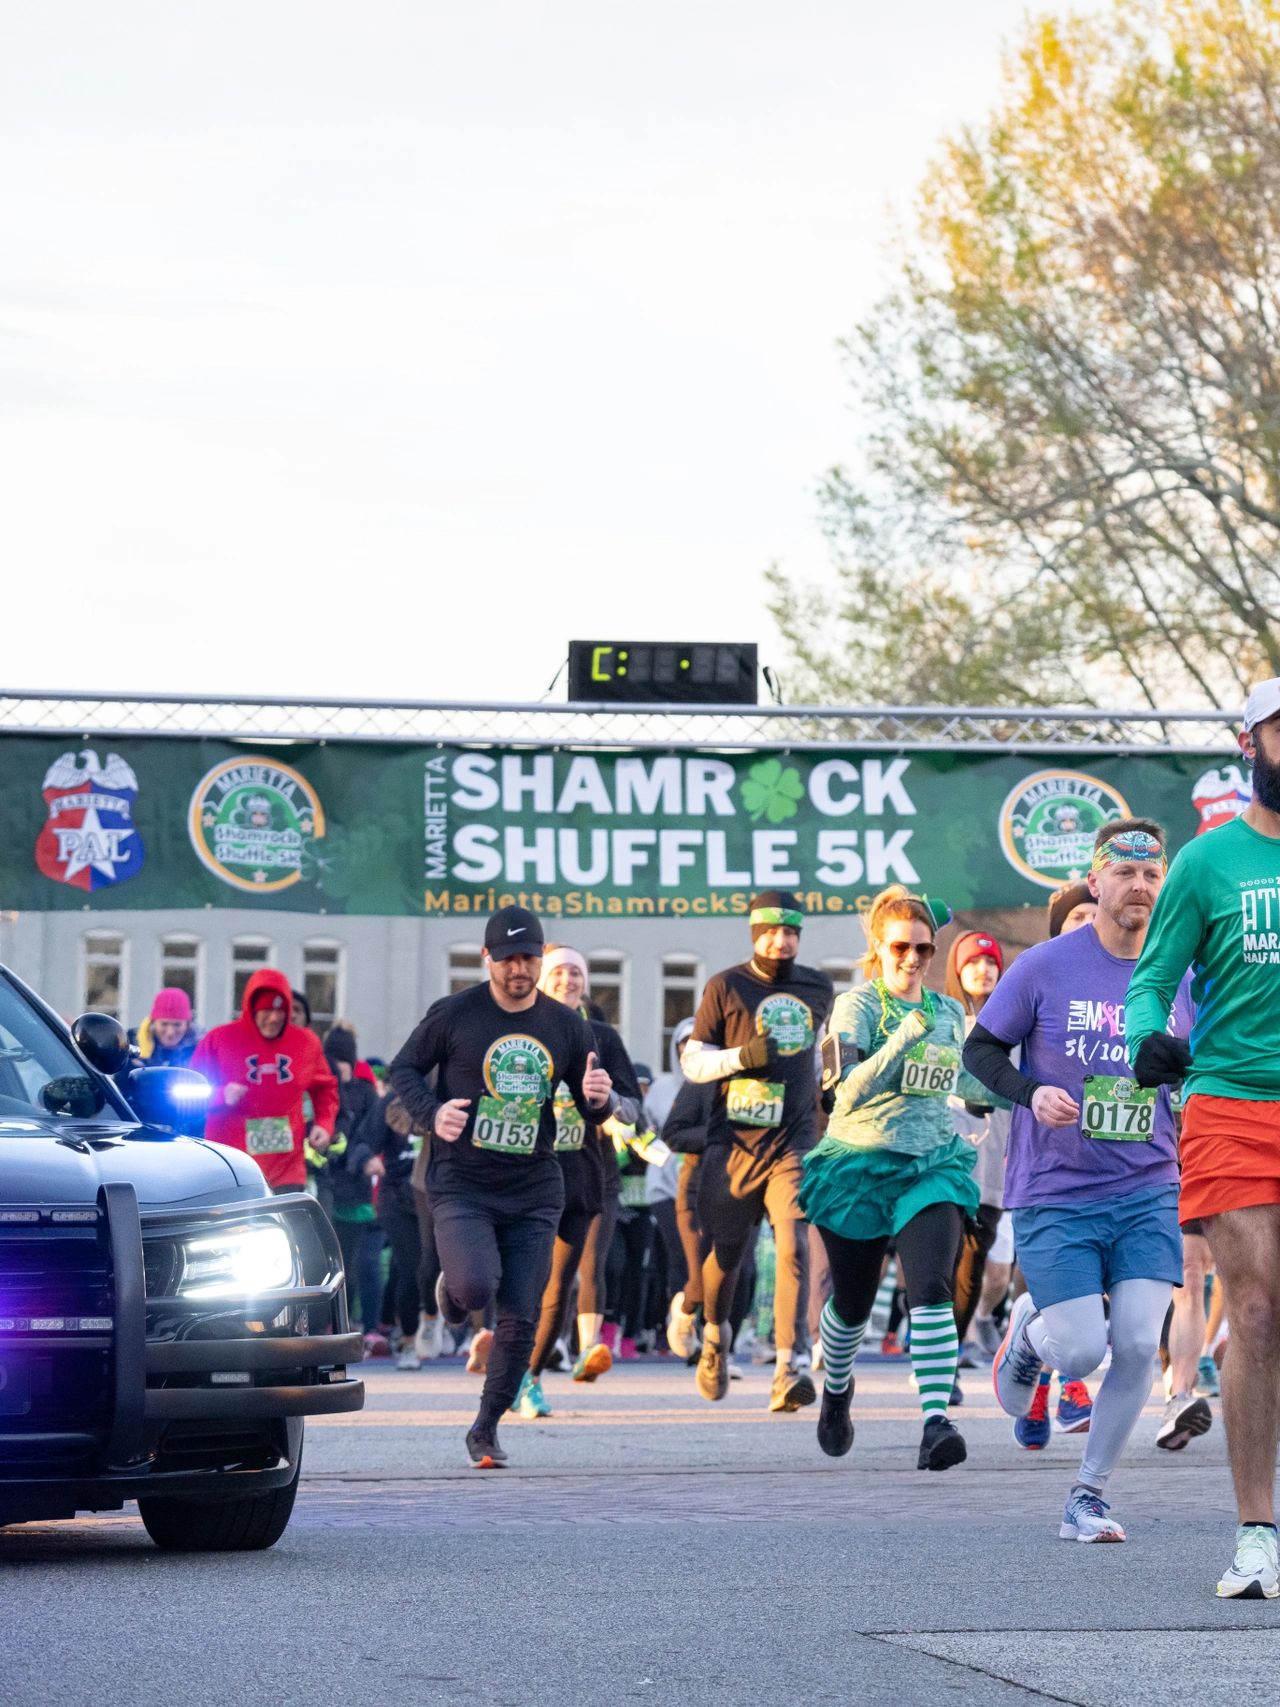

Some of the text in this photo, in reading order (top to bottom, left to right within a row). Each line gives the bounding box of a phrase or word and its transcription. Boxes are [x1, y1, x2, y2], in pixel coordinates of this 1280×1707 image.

[215, 766, 298, 801] MARIETTA
[1023, 778, 1103, 805] MARIETTA
[424, 755, 447, 879] MARIETTA
[56, 831, 132, 862] PAL
[216, 826, 302, 845] Shamrock
[1027, 831, 1097, 848] Shamro
[216, 844, 273, 864] Shuffle
[452, 824, 921, 887] SHUFFLE 5K
[424, 887, 872, 915] MariettaShamrockSfle.c
[1243, 952, 1269, 965] HALF
[1067, 1000, 1087, 1032] TEAM
[906, 1063, 955, 1091] 0168
[731, 1096, 777, 1121] 0421
[1086, 1101, 1152, 1133] 0178
[477, 1118, 535, 1147] 0153
